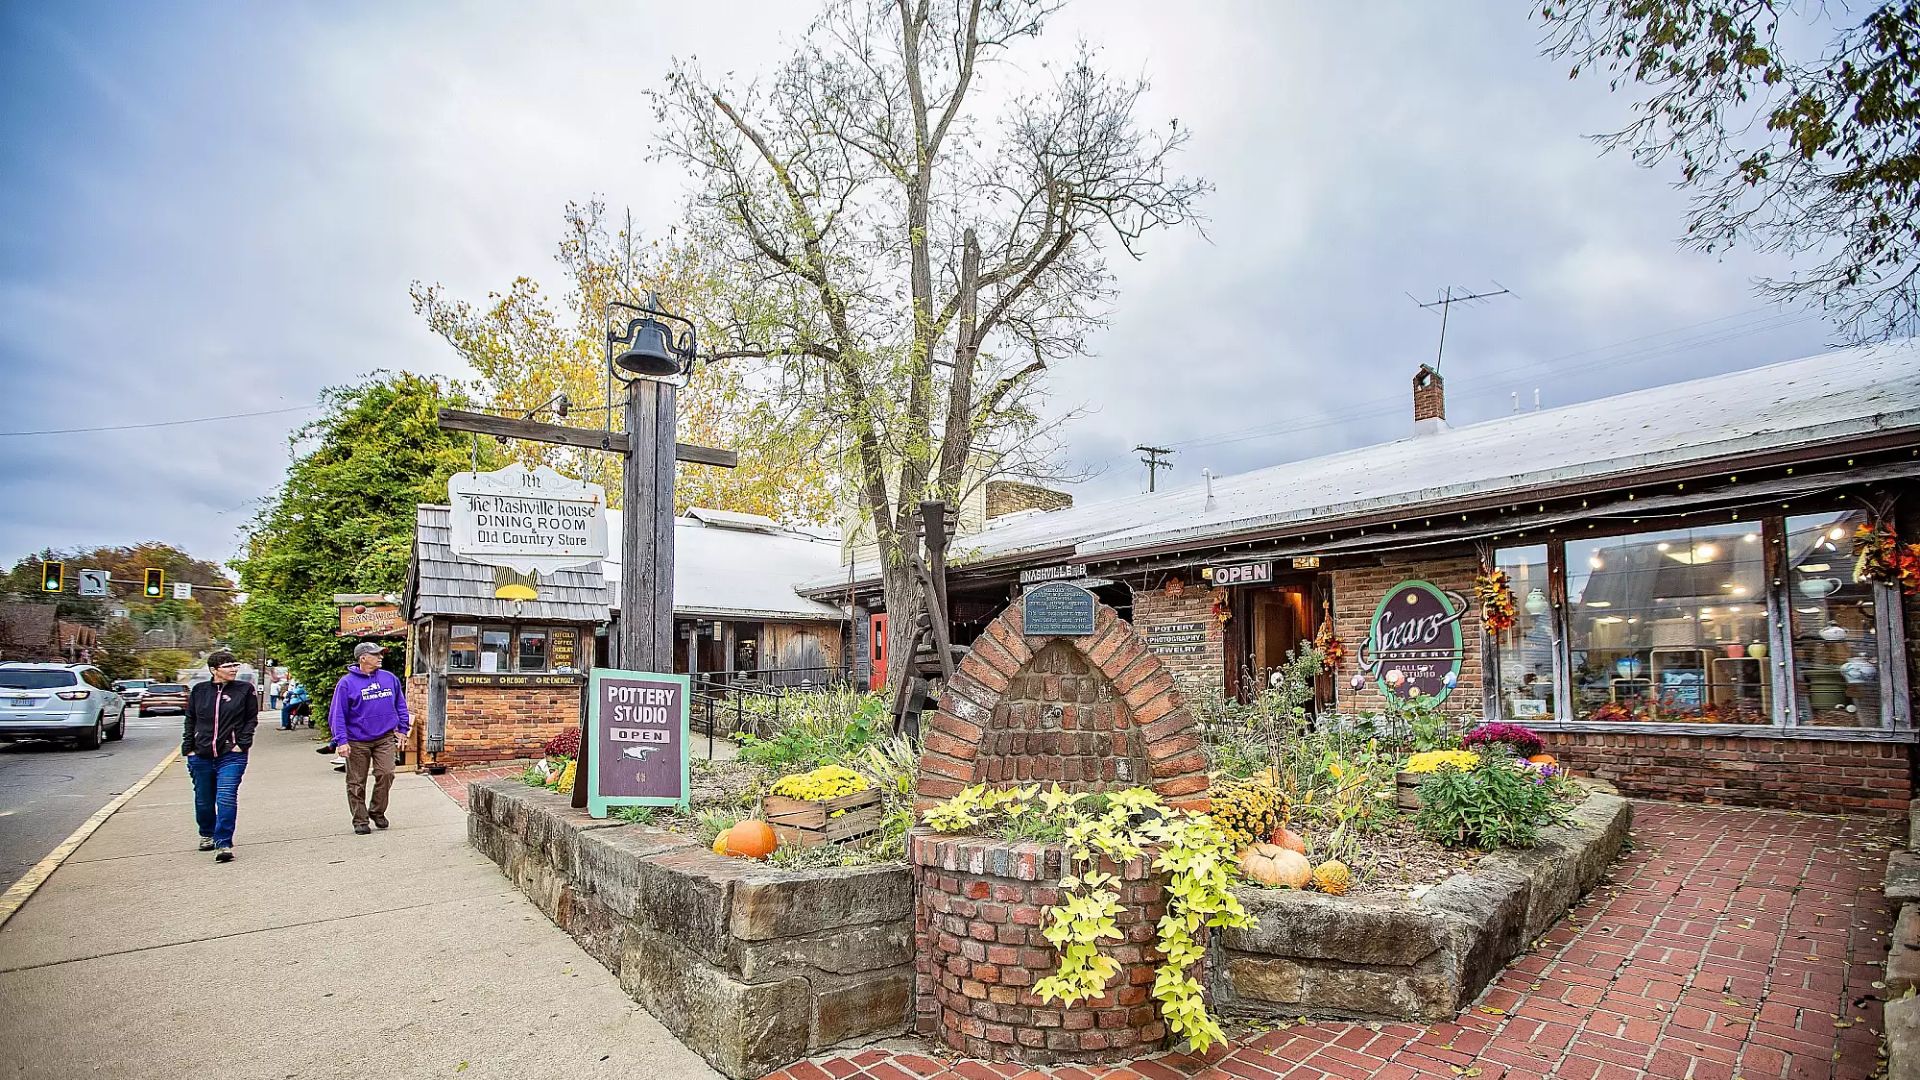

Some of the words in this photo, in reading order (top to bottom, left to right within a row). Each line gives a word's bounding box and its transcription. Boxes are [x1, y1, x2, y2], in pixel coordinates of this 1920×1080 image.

[460, 495, 490, 512] The
[494, 495, 554, 516] Nashville
[477, 514, 532, 529] DINING
[537, 518, 586, 530] ROOM
[478, 530, 498, 543] Old
[502, 531, 554, 547] Country
[558, 533, 587, 546] Store
[1025, 565, 1072, 582] NASHVILLE
[1215, 563, 1267, 584] OPEN
[1154, 624, 1195, 633] POTTERY
[1149, 634, 1200, 644] PHOTOGRAPHY
[1154, 646, 1197, 654] JEWELRY
[1380, 651, 1450, 659] POTTERY
[465, 676, 492, 684] REFRESH
[608, 686, 675, 706] POTTERY
[614, 705, 668, 724] STUDIO
[618, 731, 663, 740] OPEN
